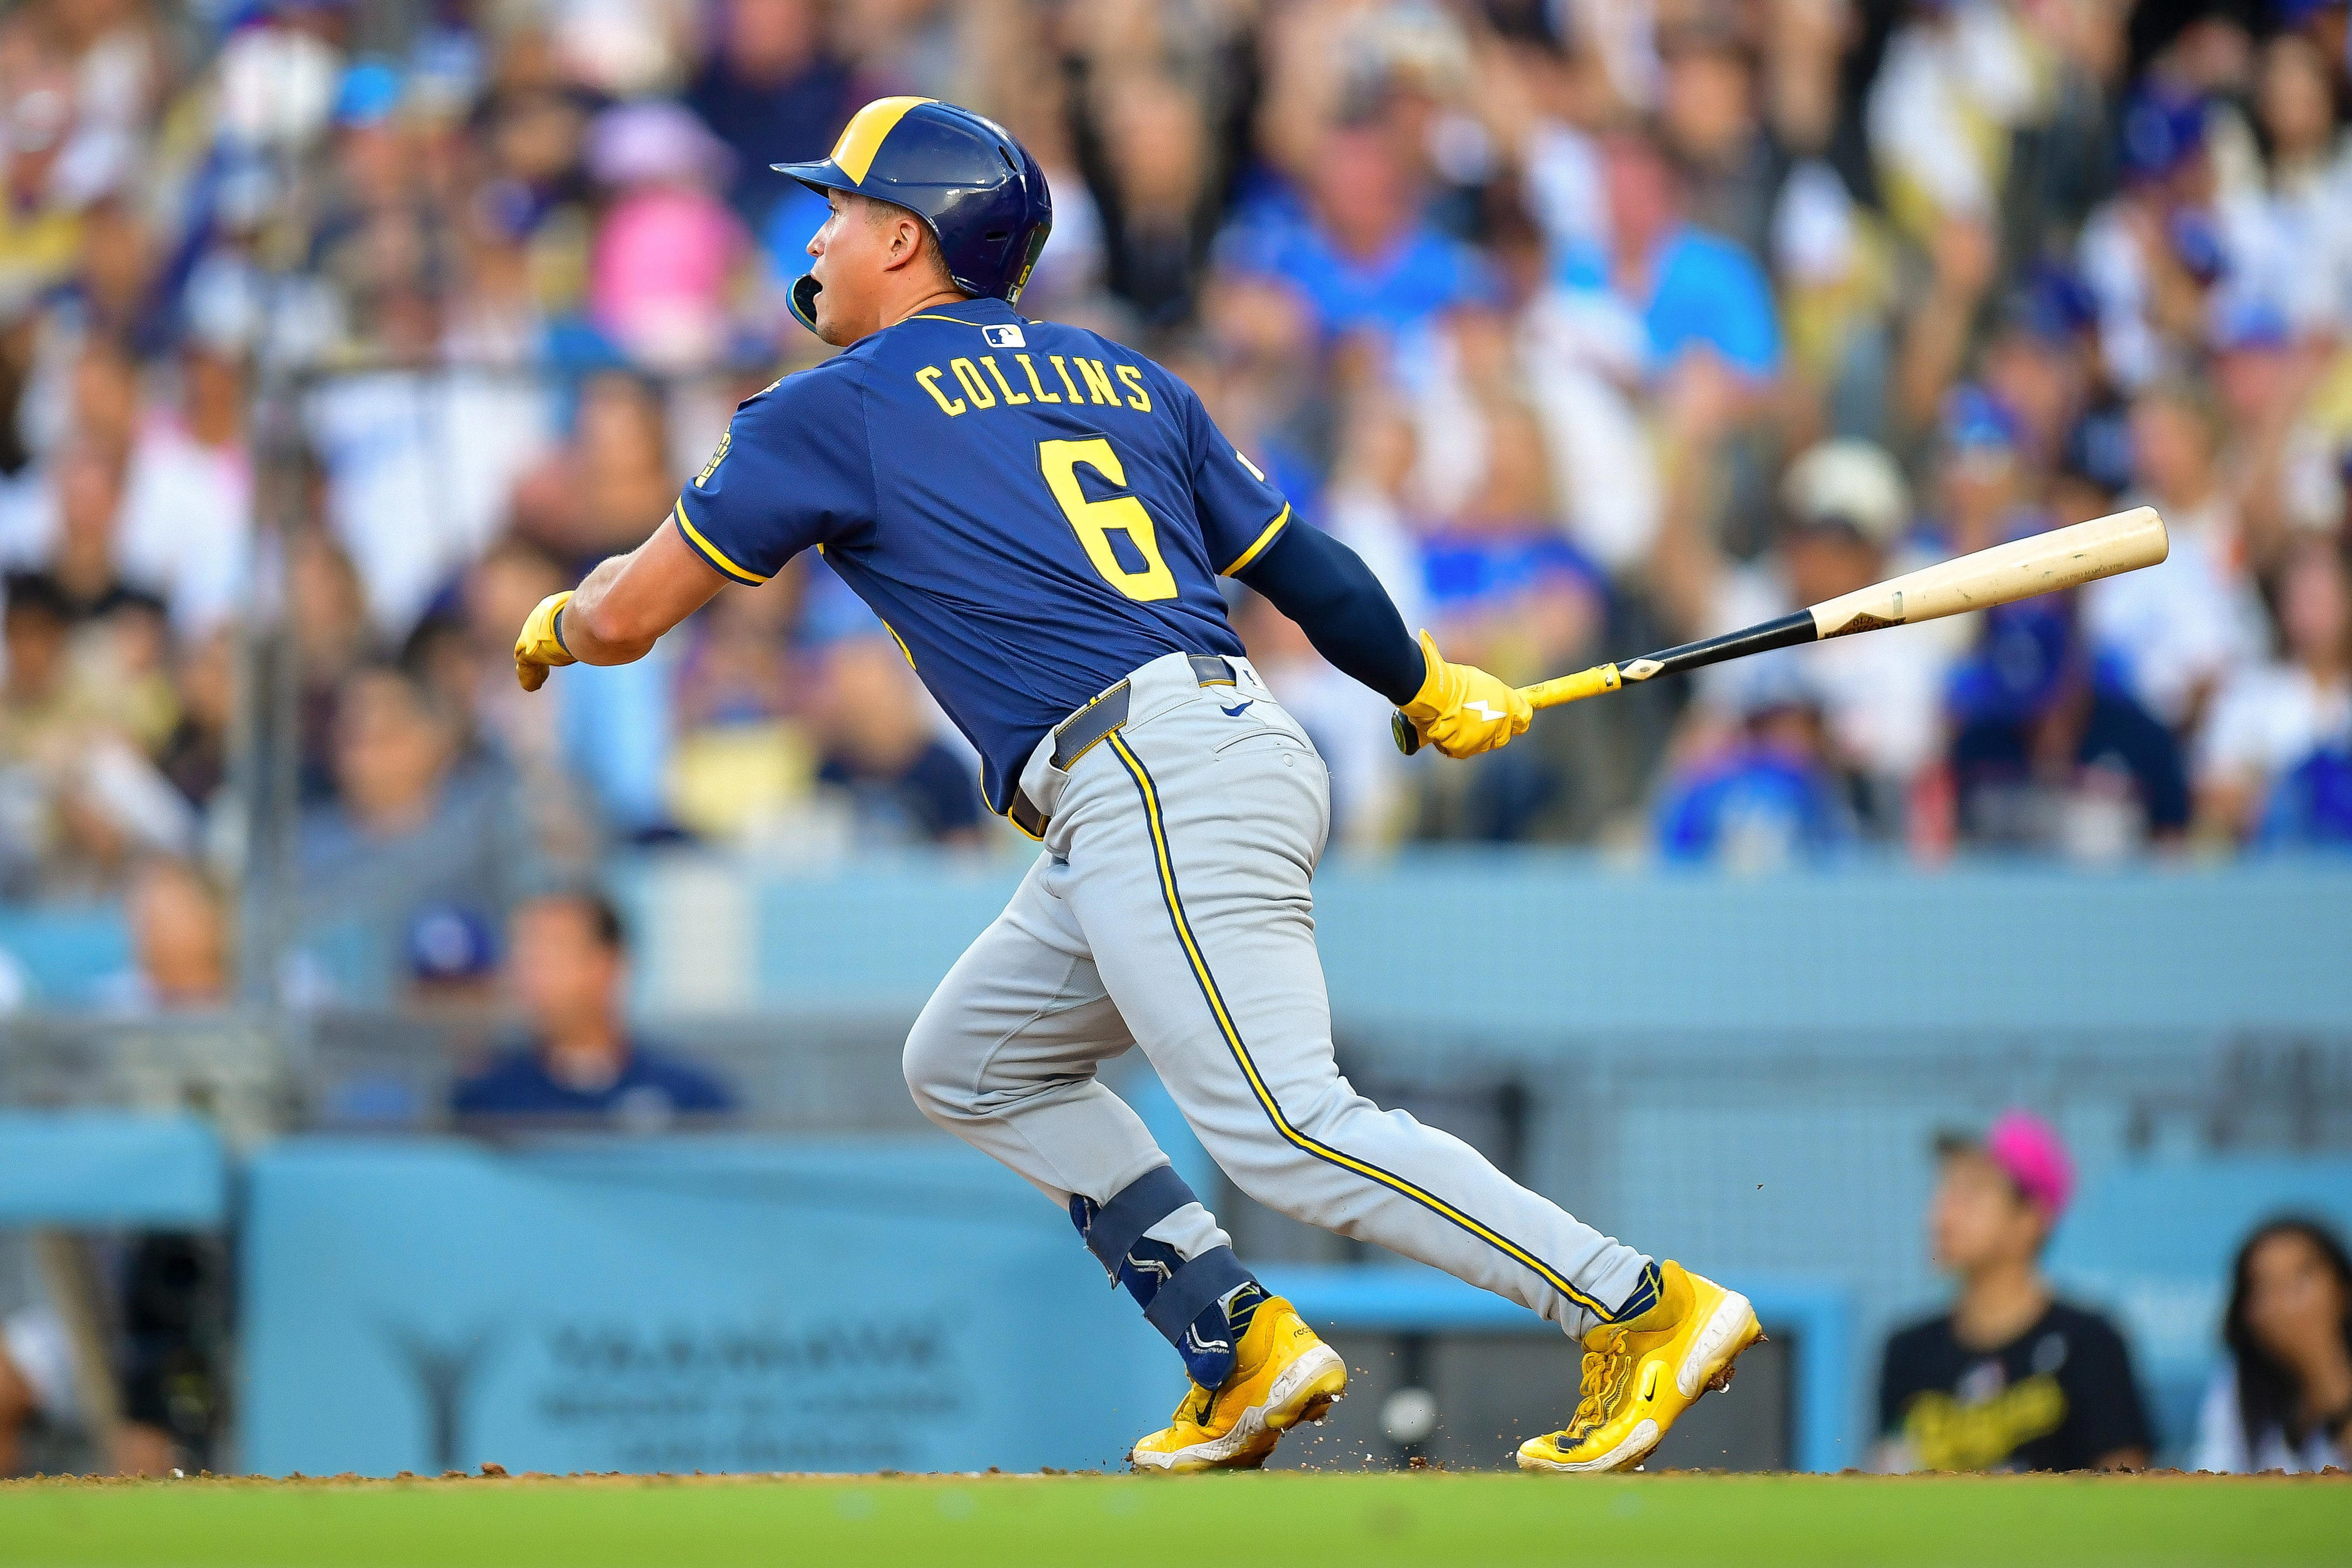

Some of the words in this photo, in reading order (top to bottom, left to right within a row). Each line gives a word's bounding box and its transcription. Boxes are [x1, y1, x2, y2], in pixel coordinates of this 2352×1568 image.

[1019, 264, 1030, 285] 6
[915, 353, 1152, 417] COLLINS
[1039, 437, 1179, 601] 6
[1853, 615, 1873, 627] OLD
